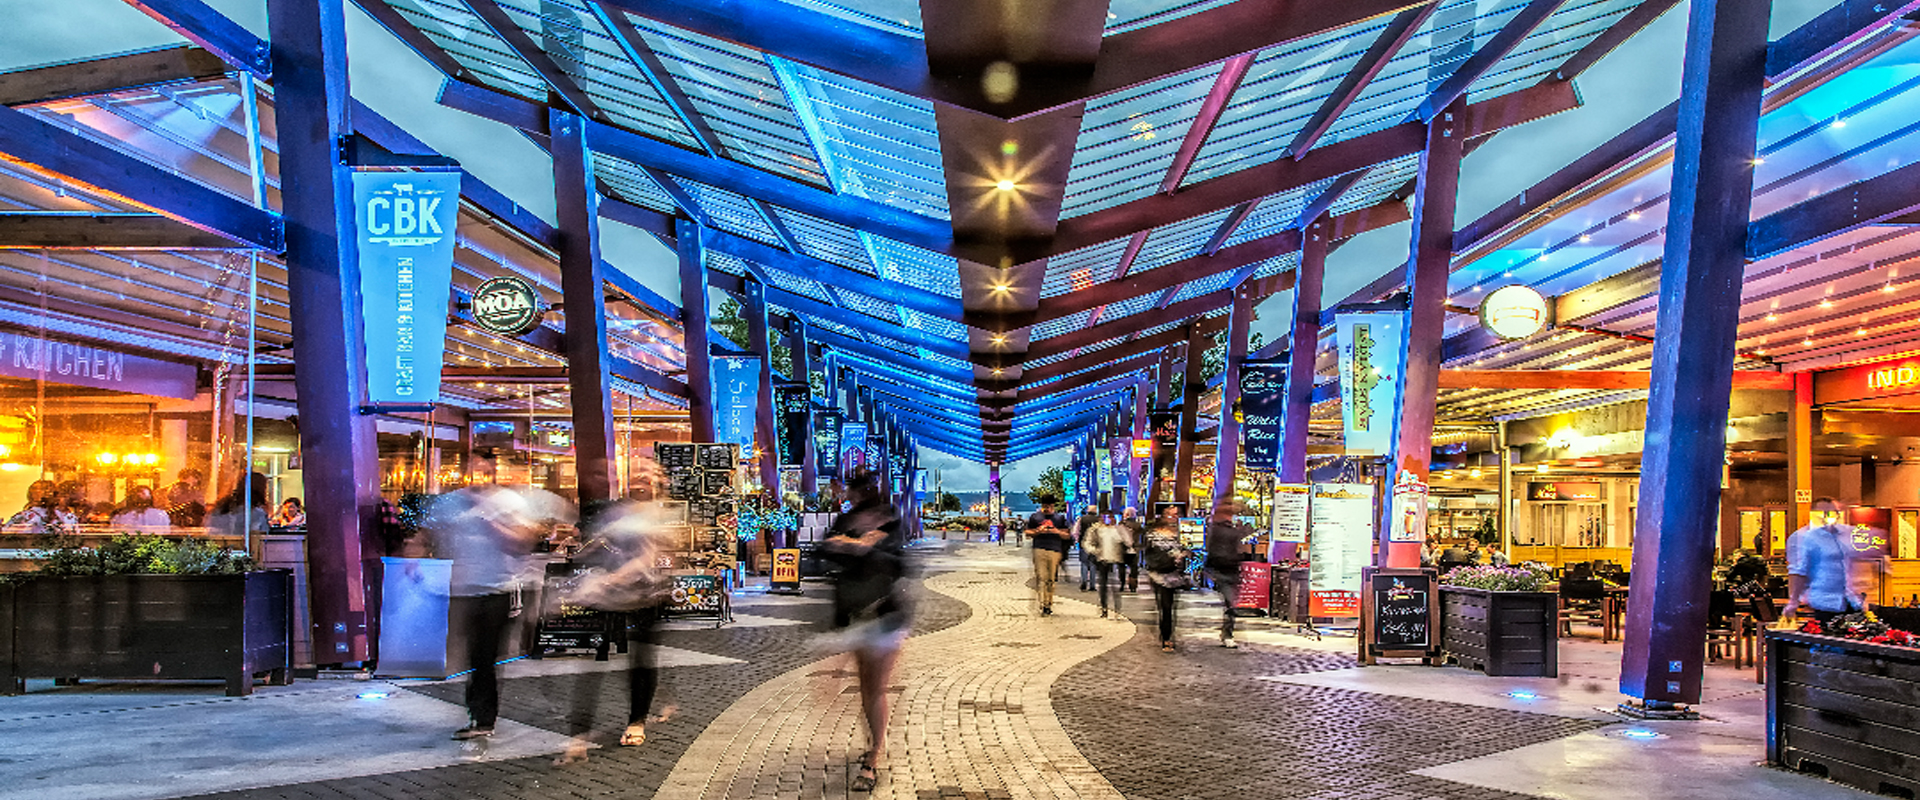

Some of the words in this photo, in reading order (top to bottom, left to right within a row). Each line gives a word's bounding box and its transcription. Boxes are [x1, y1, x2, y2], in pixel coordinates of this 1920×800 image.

[367, 197, 443, 235] CBK
[397, 257, 413, 311] KITCHEN
[474, 294, 532, 317] MOA
[396, 327, 413, 352] BAR
[13, 335, 124, 382] KITCHEN
[396, 355, 413, 395] CRAFT
[1246, 415, 1279, 425] Wild
[1247, 429, 1276, 440] Rice
